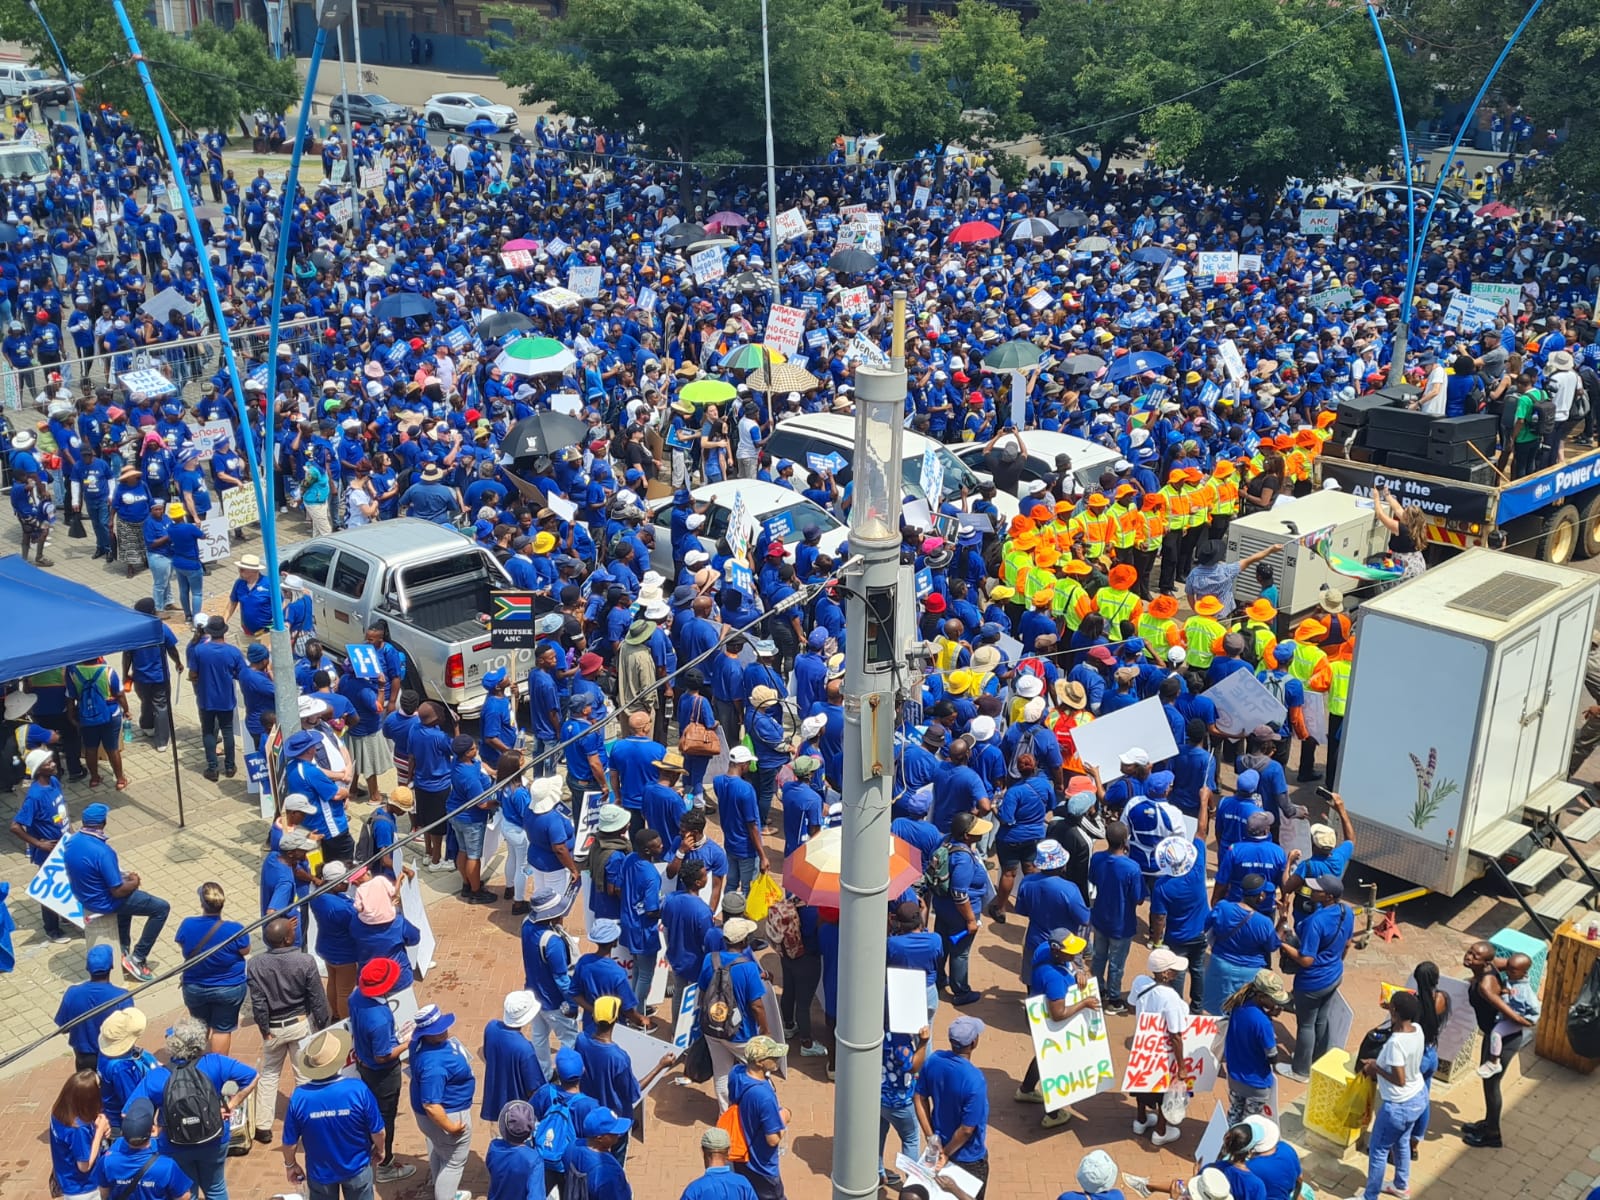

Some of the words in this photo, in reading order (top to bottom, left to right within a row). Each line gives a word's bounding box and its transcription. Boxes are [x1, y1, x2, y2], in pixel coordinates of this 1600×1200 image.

[1310, 217, 1328, 226] ANC
[696, 249, 716, 263] LOAD
[1453, 293, 1475, 304] LOAD
[767, 325, 799, 339] NOGESI
[121, 369, 152, 381] CUT
[191, 426, 226, 439] enoeg
[1374, 475, 1401, 491] Cut
[1405, 481, 1431, 496] the
[1555, 463, 1593, 494] Power
[227, 504, 258, 517] NOGES
[1402, 496, 1452, 514] power
[211, 545, 229, 557] DA
[483, 648, 532, 672] TOYO
[1042, 1059, 1114, 1105] POWER
[1126, 1069, 1152, 1090] YE
